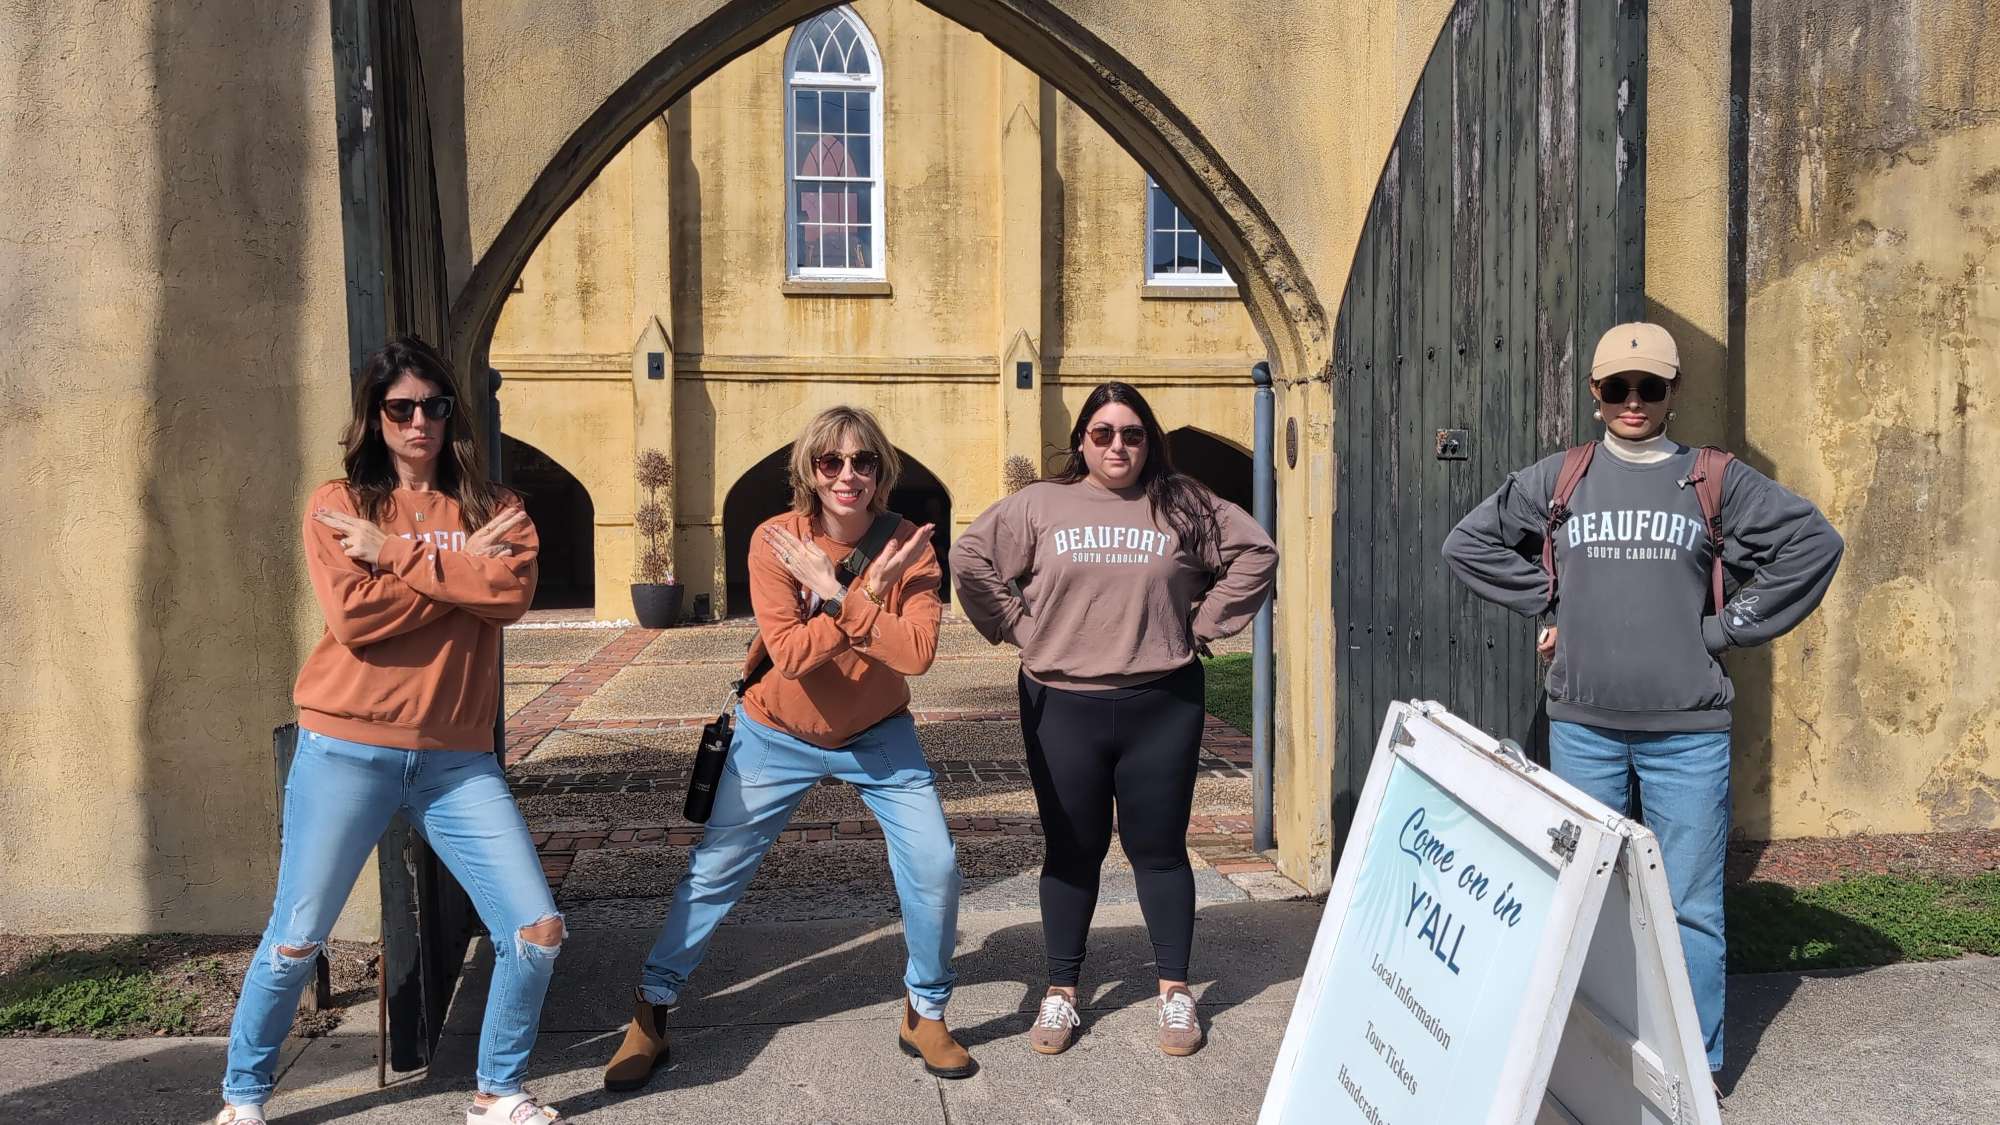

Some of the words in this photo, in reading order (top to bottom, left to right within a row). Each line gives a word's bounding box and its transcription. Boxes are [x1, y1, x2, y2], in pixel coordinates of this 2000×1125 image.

[1054, 525, 1171, 556] BEAUFORT
[1072, 552, 1101, 563] SOUTH
[1105, 553, 1149, 564] CAROLINA
[1567, 510, 1702, 551] BEAUFORT
[1587, 546, 1620, 559] SOUTH
[1626, 547, 1677, 561] CAROLINA
[1399, 807, 1455, 873] Come
[1458, 864, 1489, 901] on
[1493, 881, 1523, 928] in
[1404, 881, 1466, 976] Y'ALL
[1371, 952, 1398, 990] Local
[1394, 977, 1451, 1051] Information
[1364, 1020, 1387, 1056] Tour
[1384, 1044, 1418, 1096] Tickets
